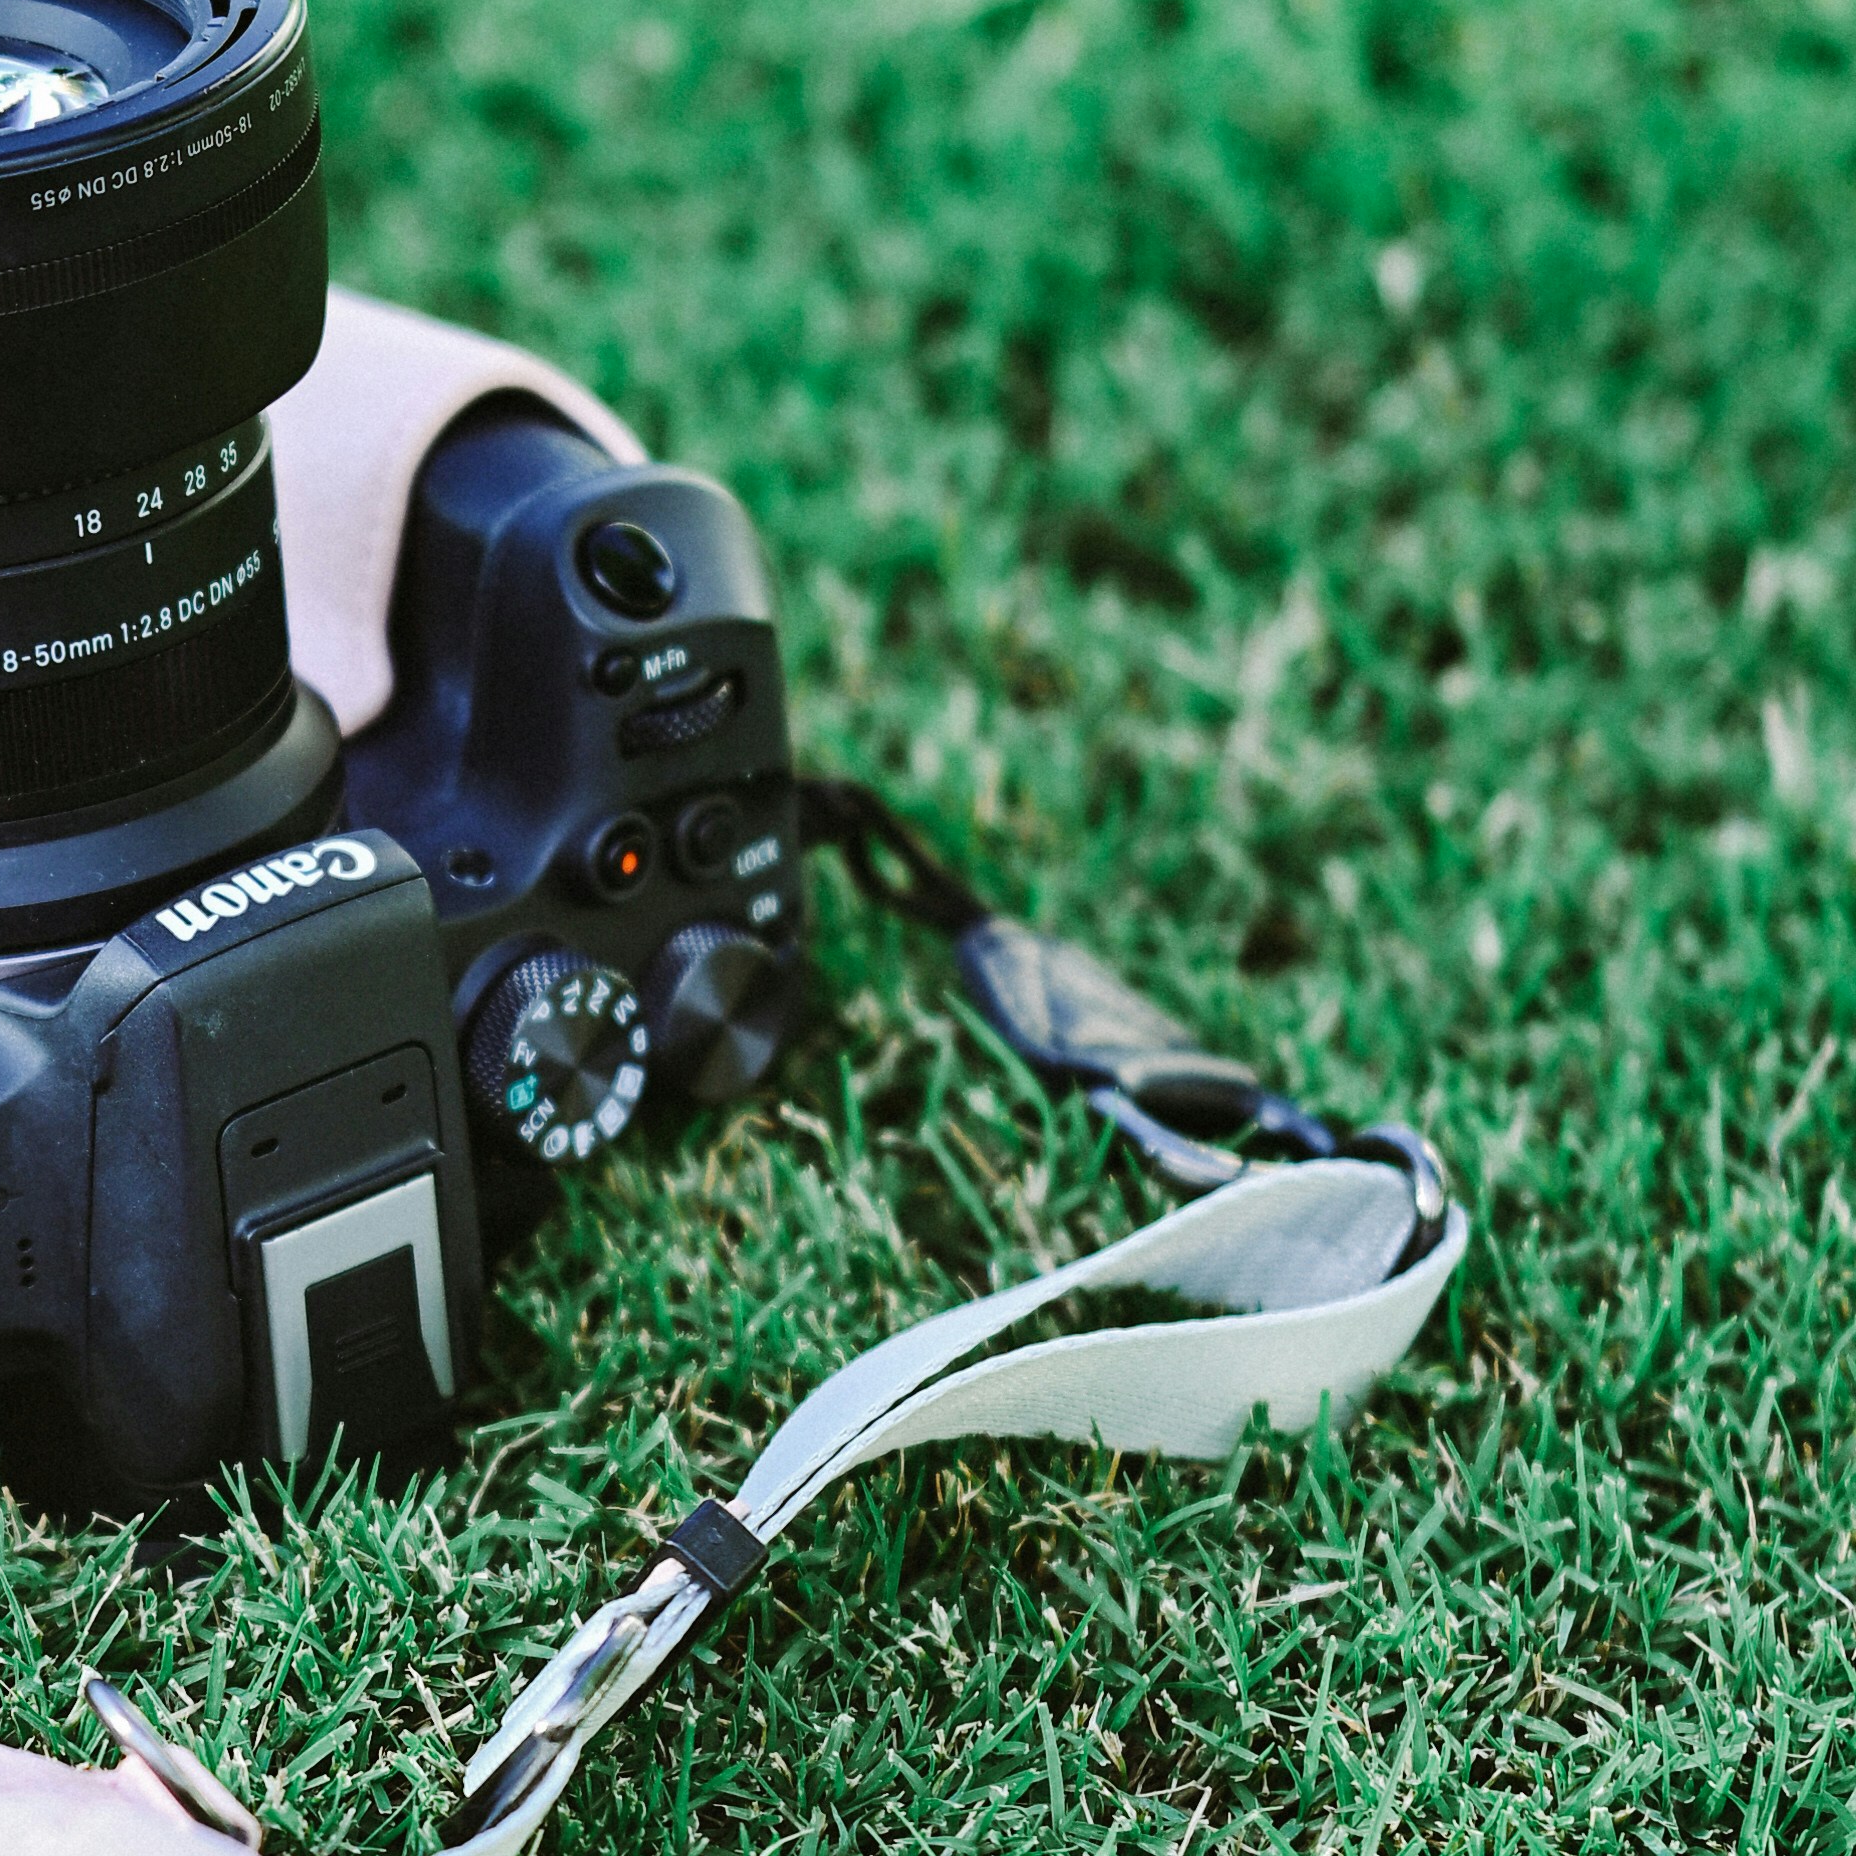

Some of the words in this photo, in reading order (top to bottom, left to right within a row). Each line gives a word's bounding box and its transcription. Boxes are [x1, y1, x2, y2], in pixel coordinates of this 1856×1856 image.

[187, 112, 252, 157] 18-50mm
[111, 166, 138, 190] DC
[143, 149, 183, 179] 1:2.8
[78, 176, 106, 200] DN
[73, 508, 102, 538] 18
[136, 486, 164, 518] 24
[184, 464, 206, 497] 28
[220, 440, 238, 473] 35
[120, 606, 172, 644] 1:2.8
[178, 590, 205, 623] DC
[210, 572, 234, 606] DN
[644, 647, 687, 680] M-Fn
[735, 836, 780, 877] LOCK
[155, 838, 378, 942] Canon
[751, 894, 779, 924] ON
[513, 1040, 537, 1067] Fv
[520, 1096, 556, 1144] SCN
